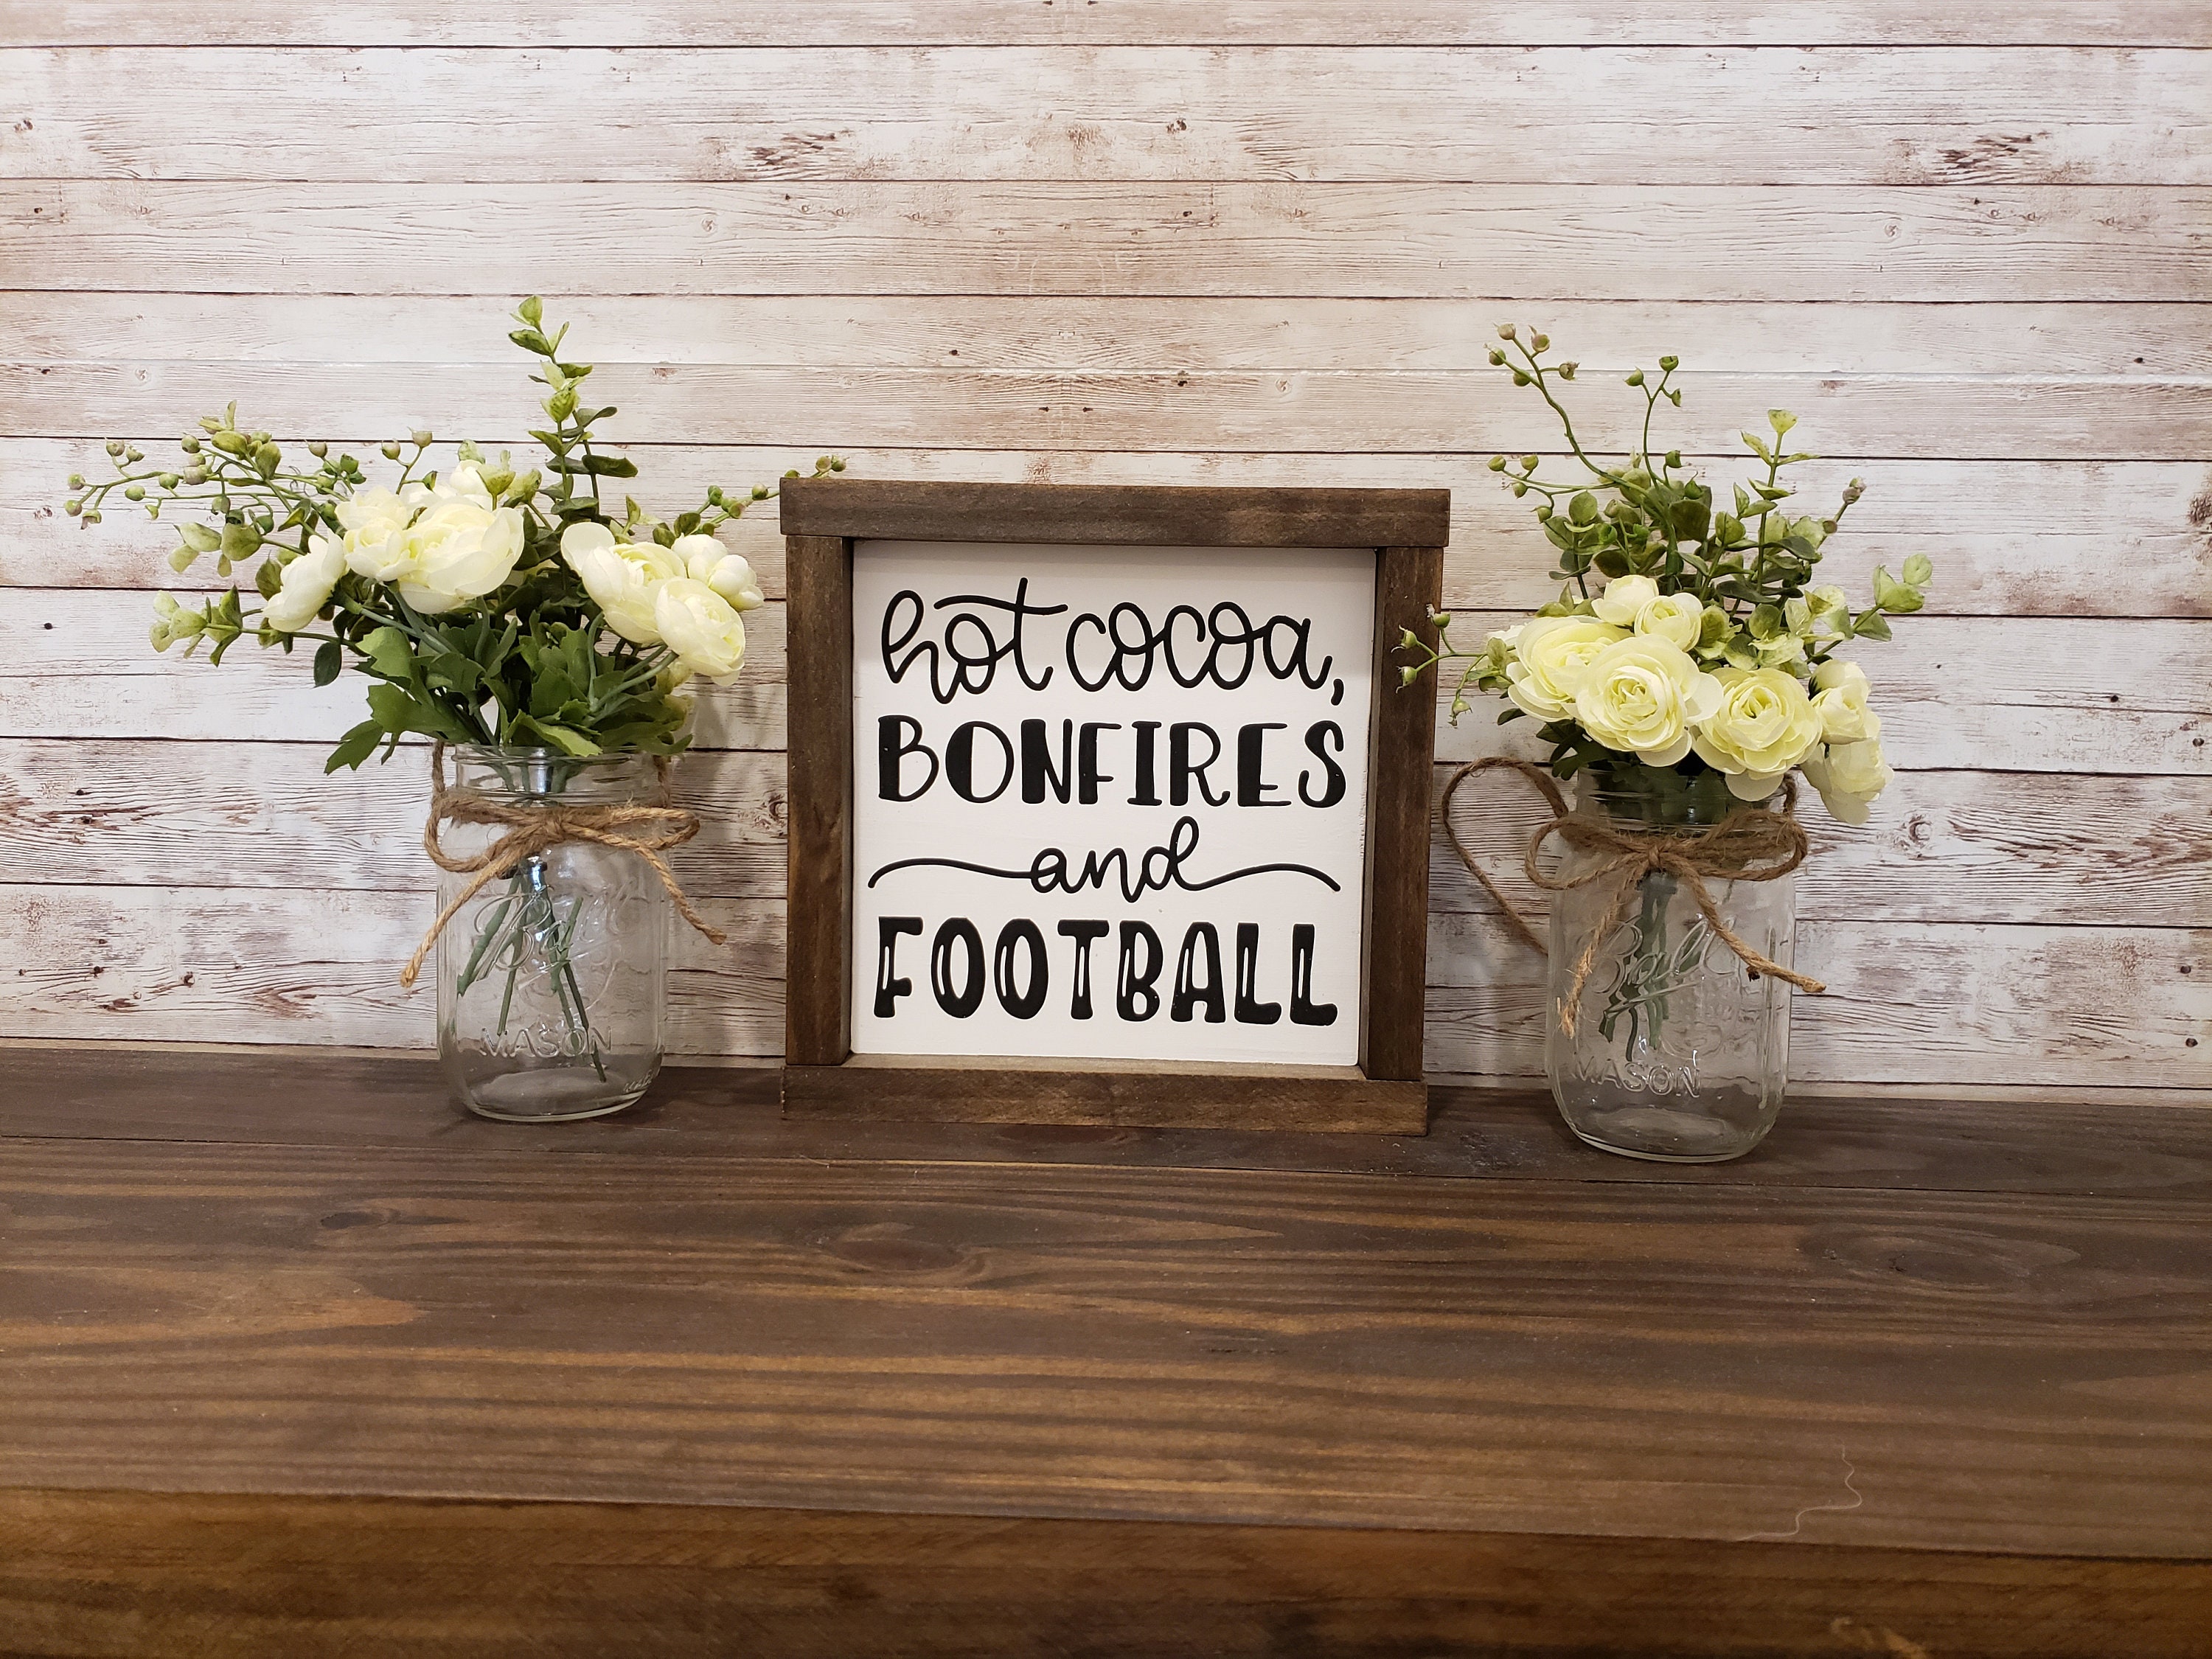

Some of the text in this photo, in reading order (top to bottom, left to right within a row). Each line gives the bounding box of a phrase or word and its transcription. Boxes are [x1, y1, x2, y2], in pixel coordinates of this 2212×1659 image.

[881, 577, 1344, 706] hot cocoa,
[877, 714, 1347, 808] BONFIRES
[873, 917, 1339, 1026] FOOTBALL
[476, 1025, 612, 1058] MASON
[1571, 1056, 1701, 1099] MASON
